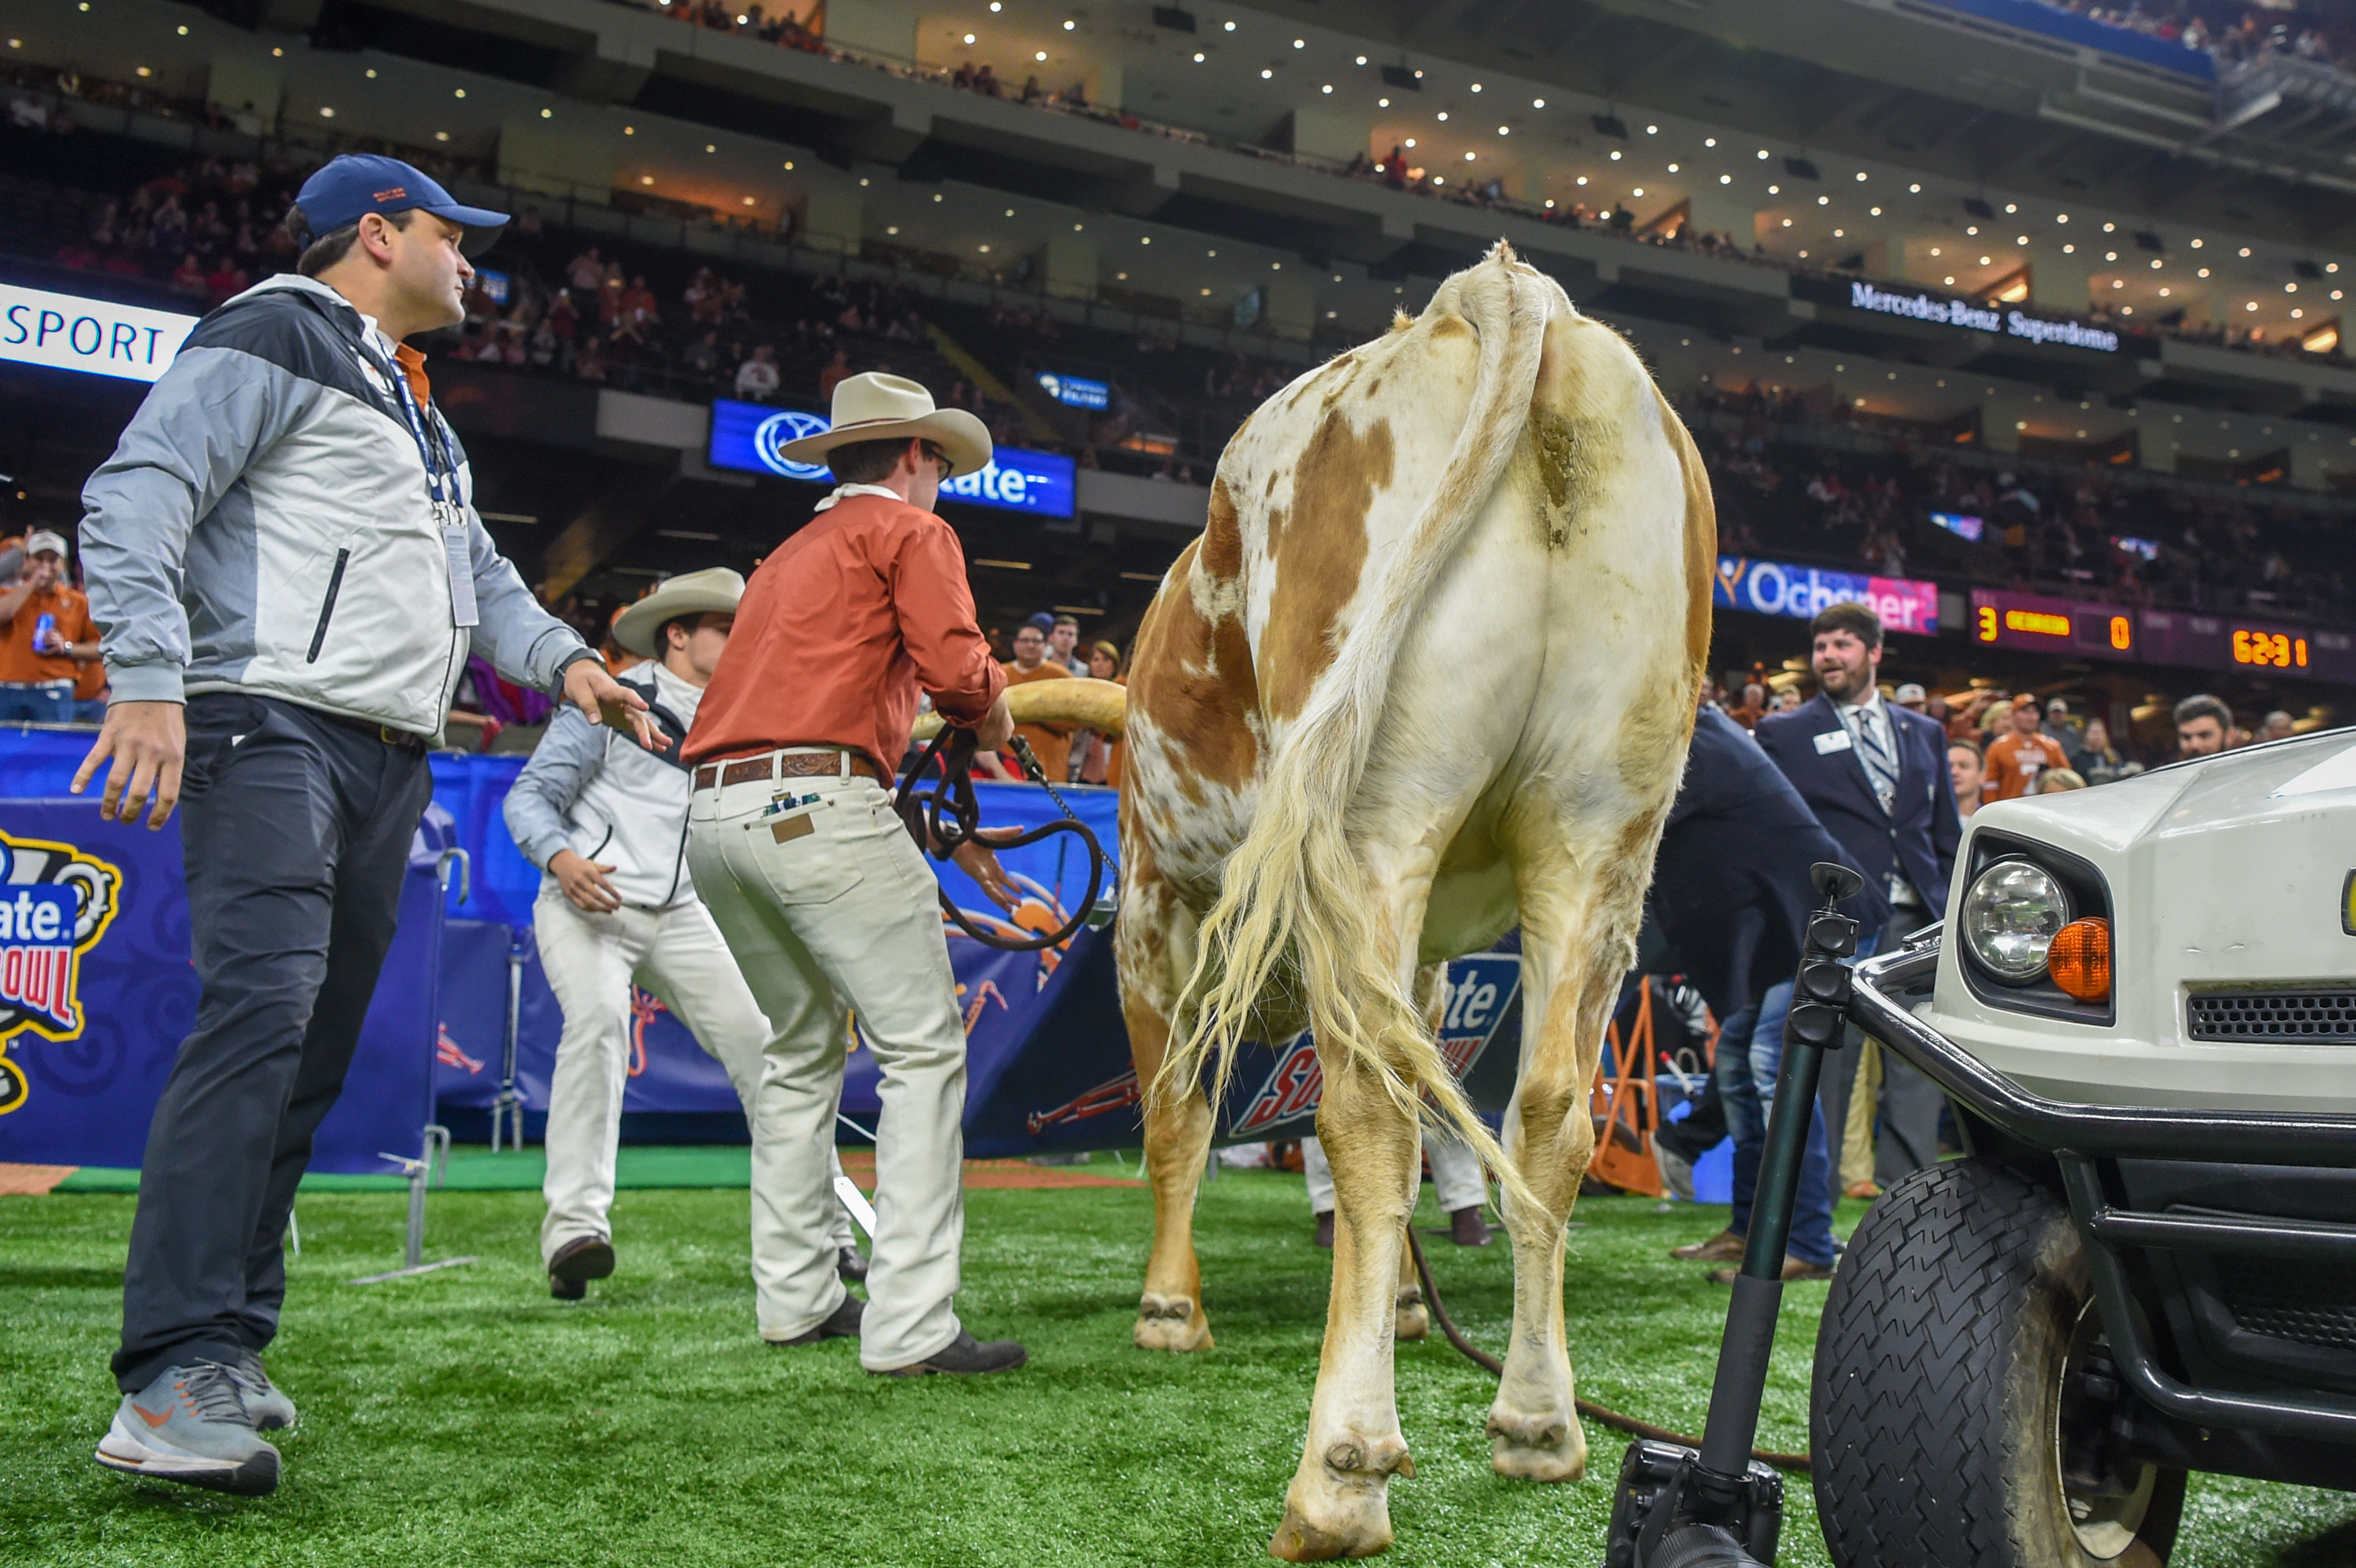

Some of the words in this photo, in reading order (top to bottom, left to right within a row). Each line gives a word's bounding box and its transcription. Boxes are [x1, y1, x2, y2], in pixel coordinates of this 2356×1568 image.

[4, 305, 163, 363] SPORT
[1852, 282, 2000, 332] Mercedes-Benz
[2007, 310, 2118, 352] Superdome
[1979, 607, 1997, 642] 3
[0, 946, 74, 1028] OWL
